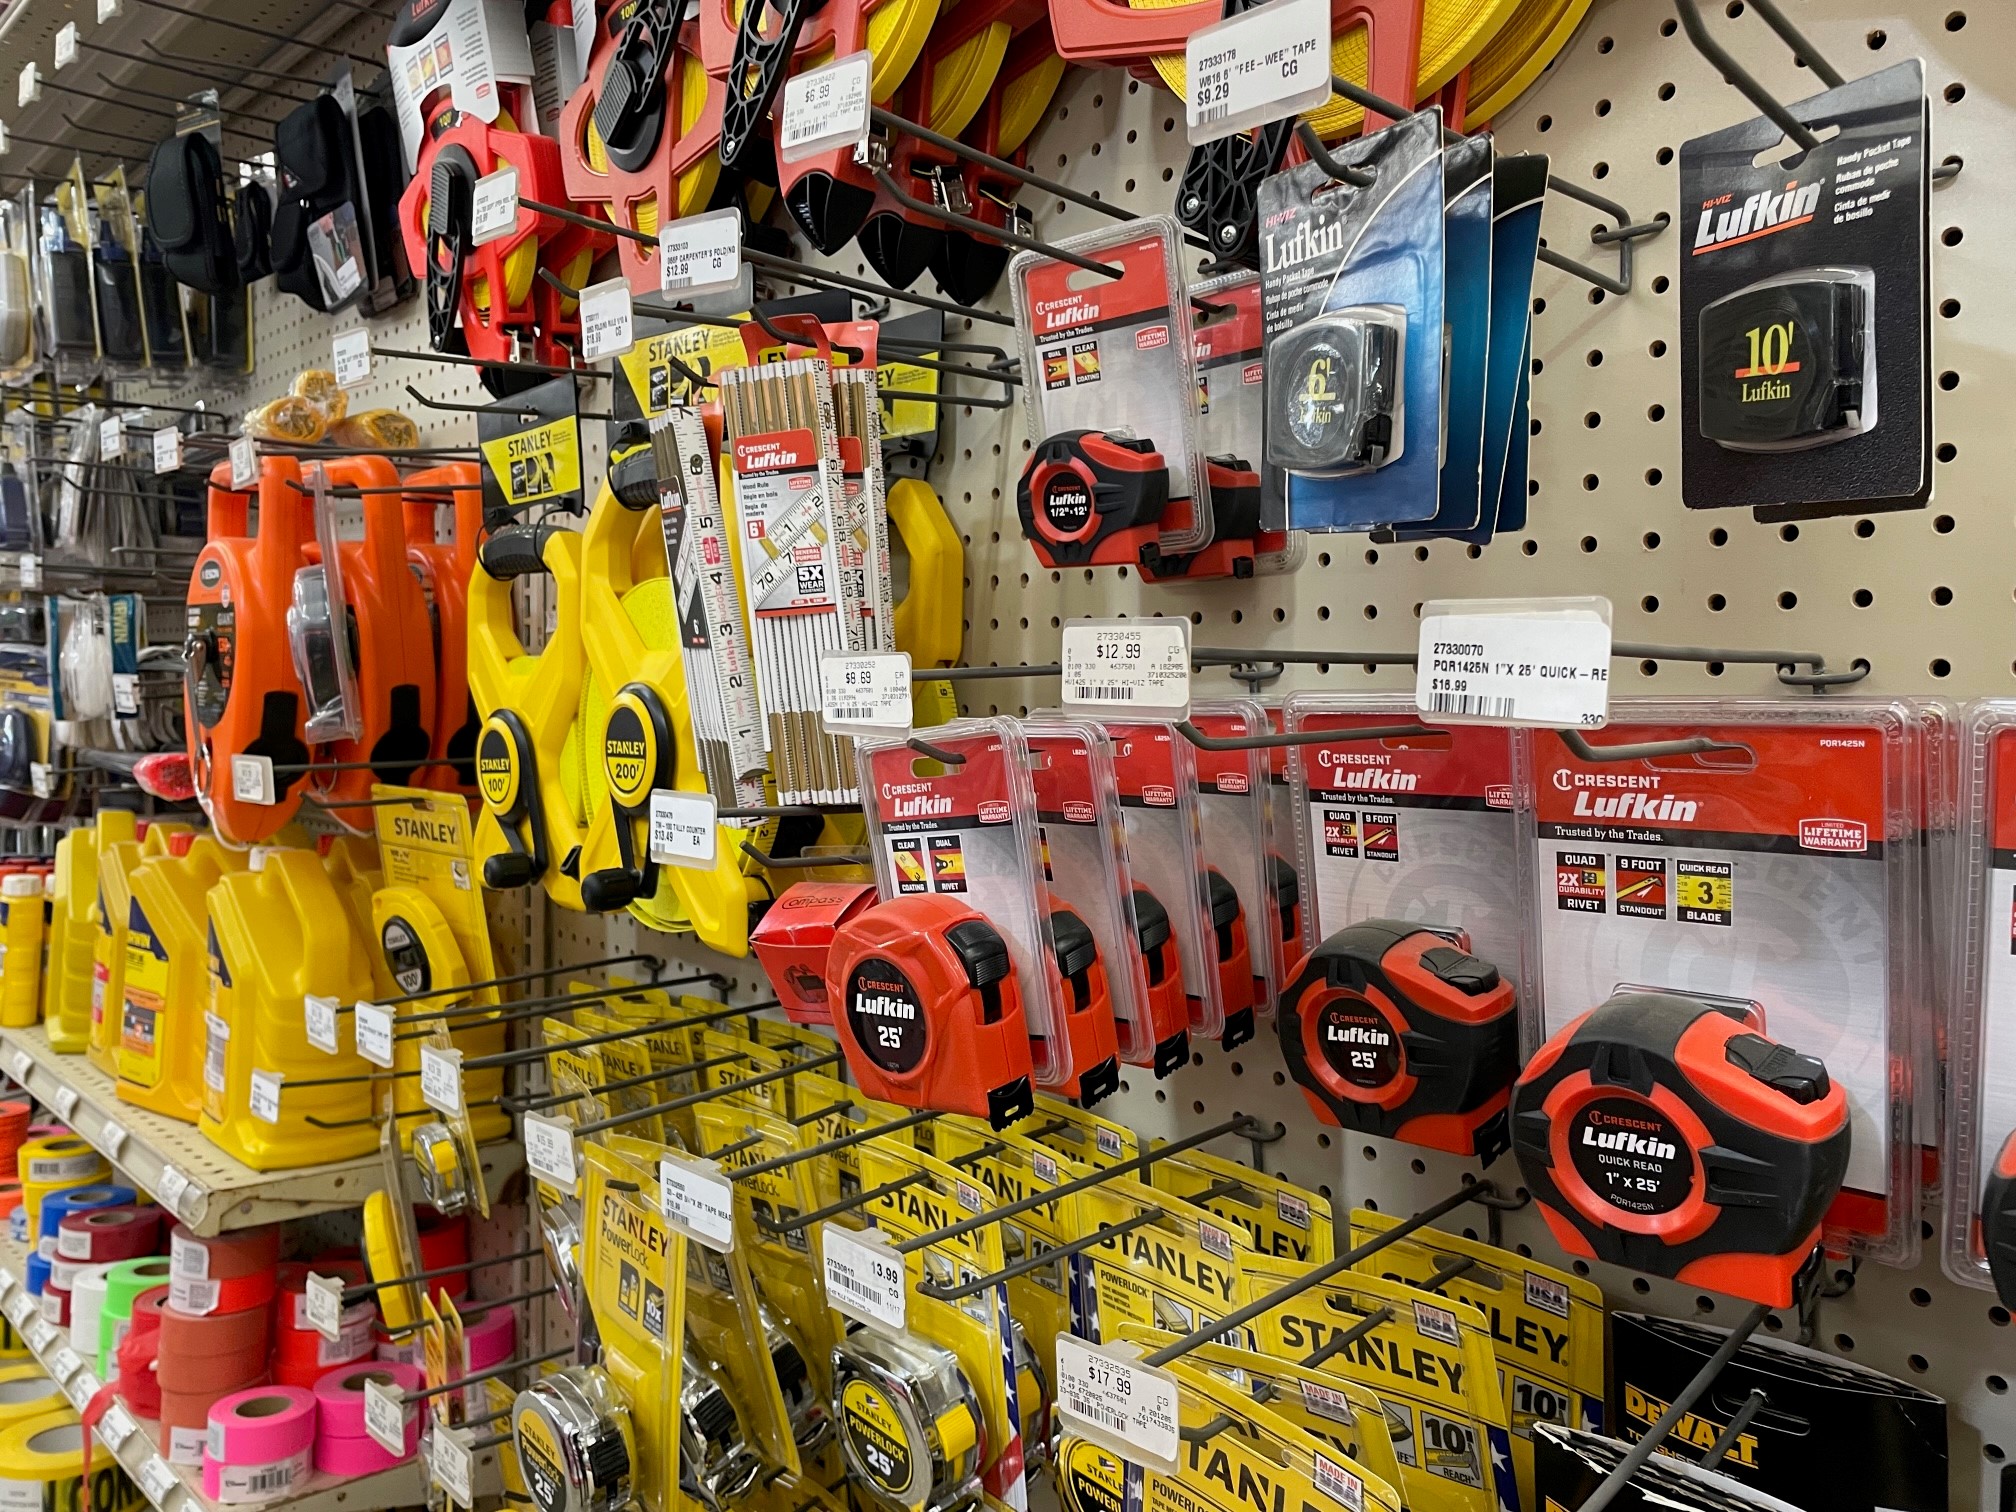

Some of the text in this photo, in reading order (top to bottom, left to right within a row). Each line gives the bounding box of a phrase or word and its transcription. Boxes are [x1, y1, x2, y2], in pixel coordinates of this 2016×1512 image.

[1292, 38, 1317, 57] TAPE
[1199, 49, 1237, 71] 27333178
[1281, 59, 1298, 79] CG
[805, 84, 830, 104] $6.99
[1197, 82, 1230, 107] $9.29
[1836, 135, 1912, 167] Handy Pocket Tape
[1835, 156, 1900, 184] Ruban de poche
[1835, 176, 1876, 196] commode
[1702, 193, 1734, 211] HI-VIZ
[1834, 189, 1892, 214] Cinta de medir
[1694, 180, 1821, 249] Lufkin
[1833, 213, 1844, 225] de
[1265, 213, 1344, 274] Lufkin
[679, 245, 736, 263] CARPENTER'S FOLDING
[712, 257, 722, 269] CG
[666, 262, 689, 278] $12.99
[1265, 265, 1315, 290] Handy Pocket Tape
[1288, 287, 1303, 302] poche
[1303, 278, 1329, 296] commode
[1045, 294, 1083, 309] CRESCENT
[1046, 302, 1101, 329] Lufkin
[1266, 302, 1305, 322] Cinta medir
[1274, 318, 1294, 332] bolsillo
[1039, 332, 1058, 345] Trusted
[1137, 330, 1167, 342] LIFETIME
[649, 329, 711, 363] STANLEY
[1075, 342, 1096, 355] CLEAR
[1744, 320, 1795, 378] 10'
[1076, 372, 1101, 385] COATING
[1741, 379, 1792, 403] Lufkin
[507, 429, 552, 458] STANLEY
[746, 442, 780, 454] CRESCENT
[746, 449, 798, 470] Lufkin
[757, 481, 769, 489] Rule
[1049, 493, 1087, 507] Lufkin
[749, 521, 763, 538] 6'
[795, 547, 821, 555] GENERAL
[798, 566, 823, 582] 5X
[799, 580, 824, 590] WEAR
[1096, 643, 1141, 659] $12.99
[1433, 642, 1484, 656] 27330070
[606, 739, 646, 756] STANLEY
[480, 758, 510, 772] STANLEY
[1332, 754, 1392, 766] CRESCENT
[615, 763, 640, 780] 200'
[1333, 767, 1418, 791] Lufkin
[488, 777, 505, 792] 100'
[891, 782, 933, 795] CRESCENT
[1574, 774, 1661, 789] CRESCENT
[894, 794, 953, 818] Lufkin
[1321, 792, 1369, 804] Trusted by the
[1573, 791, 1699, 823] Lufkin
[1329, 812, 1394, 825] QUAD FOOT
[394, 816, 457, 845] STANLEY
[655, 829, 674, 843] $13.49
[1326, 826, 1340, 837] 2X
[1554, 826, 1664, 843] Trusted by the Trades.
[1803, 826, 1862, 840] LIFETIME
[692, 835, 701, 846] EA
[897, 839, 953, 850] CLEAR DUAL
[1803, 836, 1862, 850] WARRANTY
[1332, 846, 1355, 857] RIVET
[1564, 854, 1730, 876] QUAD 9 FOOT QUICK READ
[902, 882, 960, 892] COATING RIVET
[1558, 872, 1714, 905] 2X 3
[1558, 886, 1606, 897] DURABILITY
[781, 895, 845, 910] Compass
[1567, 898, 1723, 923] RIVET STANDOUT BLADE
[867, 979, 905, 994] CRESCENT
[855, 992, 916, 1021] Lufkin
[1339, 1014, 1379, 1025] CRESCENT
[877, 1025, 903, 1050] 25'
[1327, 1025, 1390, 1047] Lufkin
[1350, 1051, 1378, 1069] 25'
[1603, 1114, 1663, 1133] CRESCENT
[1582, 1126, 1677, 1160] Lufkin
[1598, 1153, 1663, 1174] QUICK READ
[1605, 1172, 1661, 1193] 1" 25'
[602, 1195, 670, 1258] STANLEY
[601, 1219, 649, 1268] PowerLock
[1098, 1221, 1233, 1303] STANLEY
[871, 1261, 898, 1285] 13.99
[1100, 1269, 1148, 1299] POWERLOCK
[1280, 1315, 1466, 1396] STANLEY
[1088, 1355, 1131, 1379] 27332535
[1088, 1366, 1132, 1396] $17.99
[1156, 1395, 1169, 1407] CG
[1304, 1384, 1330, 1399] MADE
[855, 1400, 893, 1433] STANLEY
[1132, 1417, 1148, 1430] TAPE
[849, 1413, 906, 1465] POWERLOCK
[1425, 1418, 1475, 1455] 10'
[865, 1443, 896, 1477] 25'
[1319, 1459, 1346, 1481] MADE
[534, 1471, 555, 1505] 25'
